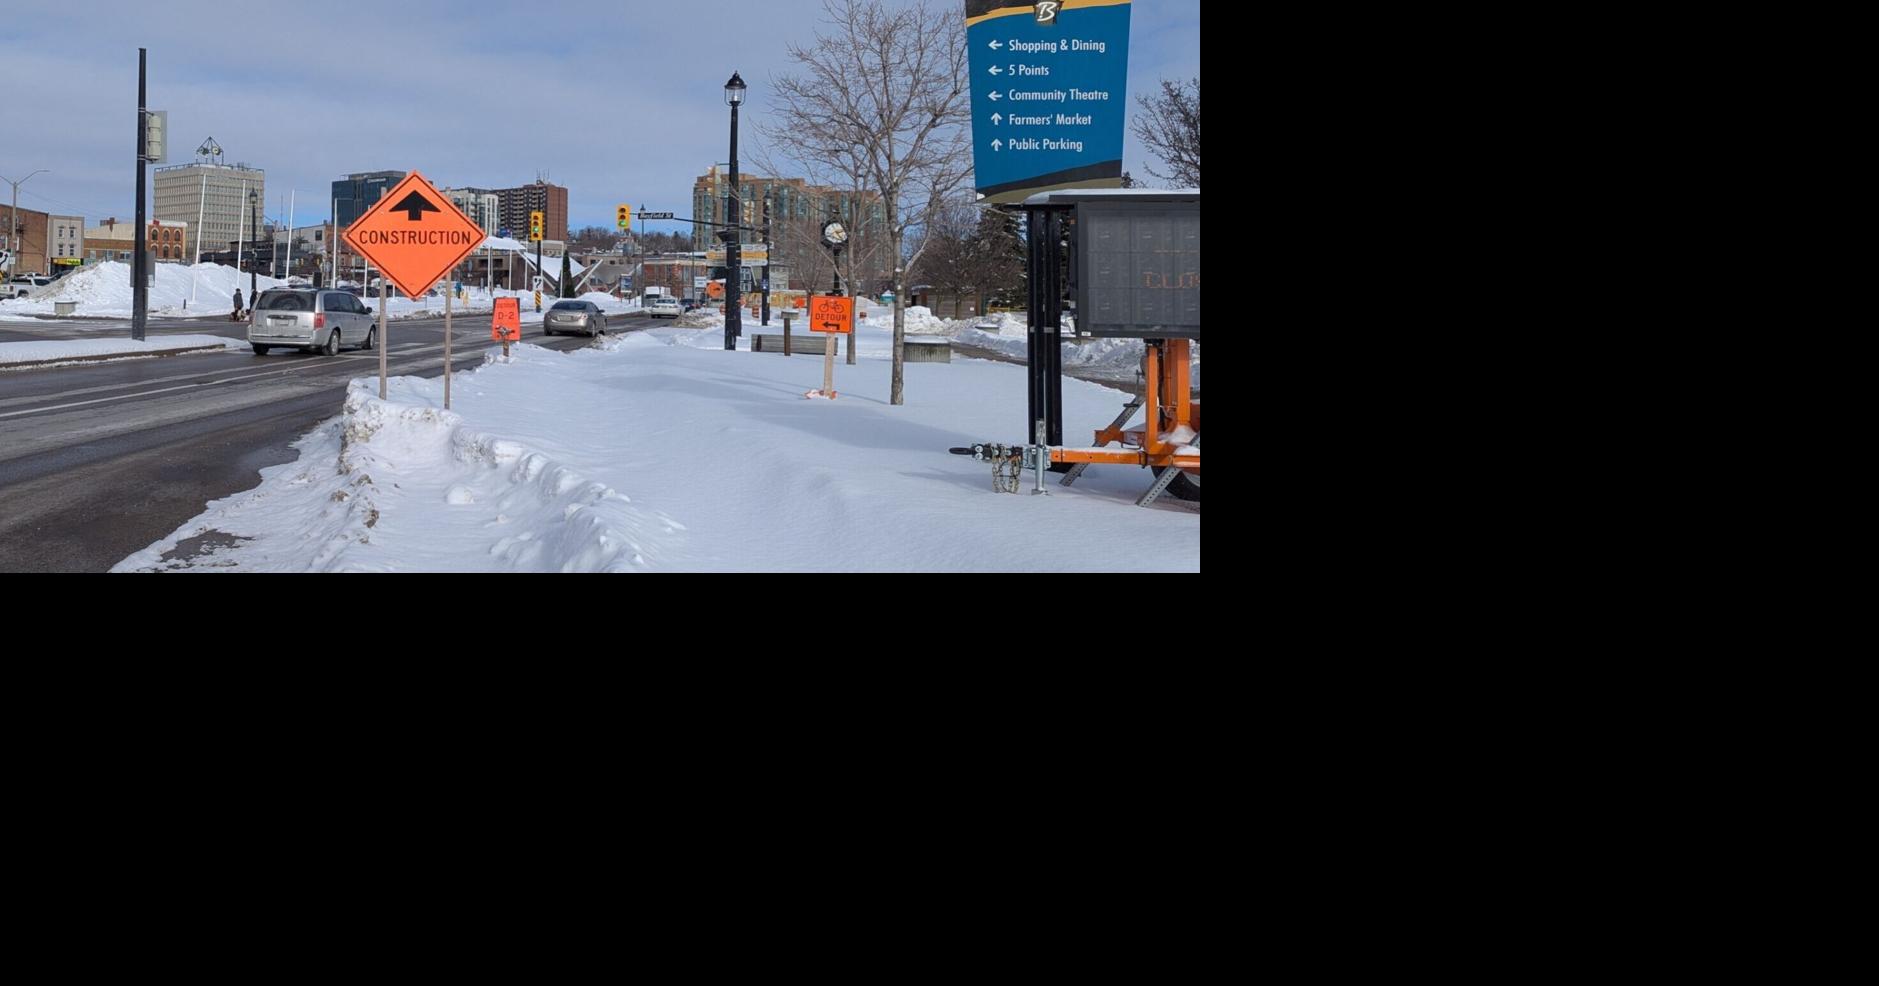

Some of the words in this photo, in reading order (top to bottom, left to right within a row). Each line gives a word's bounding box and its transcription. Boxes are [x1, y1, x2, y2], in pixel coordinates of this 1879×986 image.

[1008, 39, 1057, 54] Shopping
[1060, 39, 1068, 51] &
[1071, 39, 1106, 54] Dining
[1008, 64, 1016, 76] 5
[1018, 64, 1050, 76] Points
[1008, 88, 1067, 103] Community
[1069, 88, 1109, 101] Theatre
[1009, 113, 1053, 125] Farmers'
[1055, 112, 1092, 125] Market
[1009, 137, 1040, 150] Public
[1042, 137, 1083, 153] Parking
[359, 230, 471, 245] CONSTRUCTION
[498, 311, 515, 320] D-2
[815, 313, 848, 321] DETOUR
